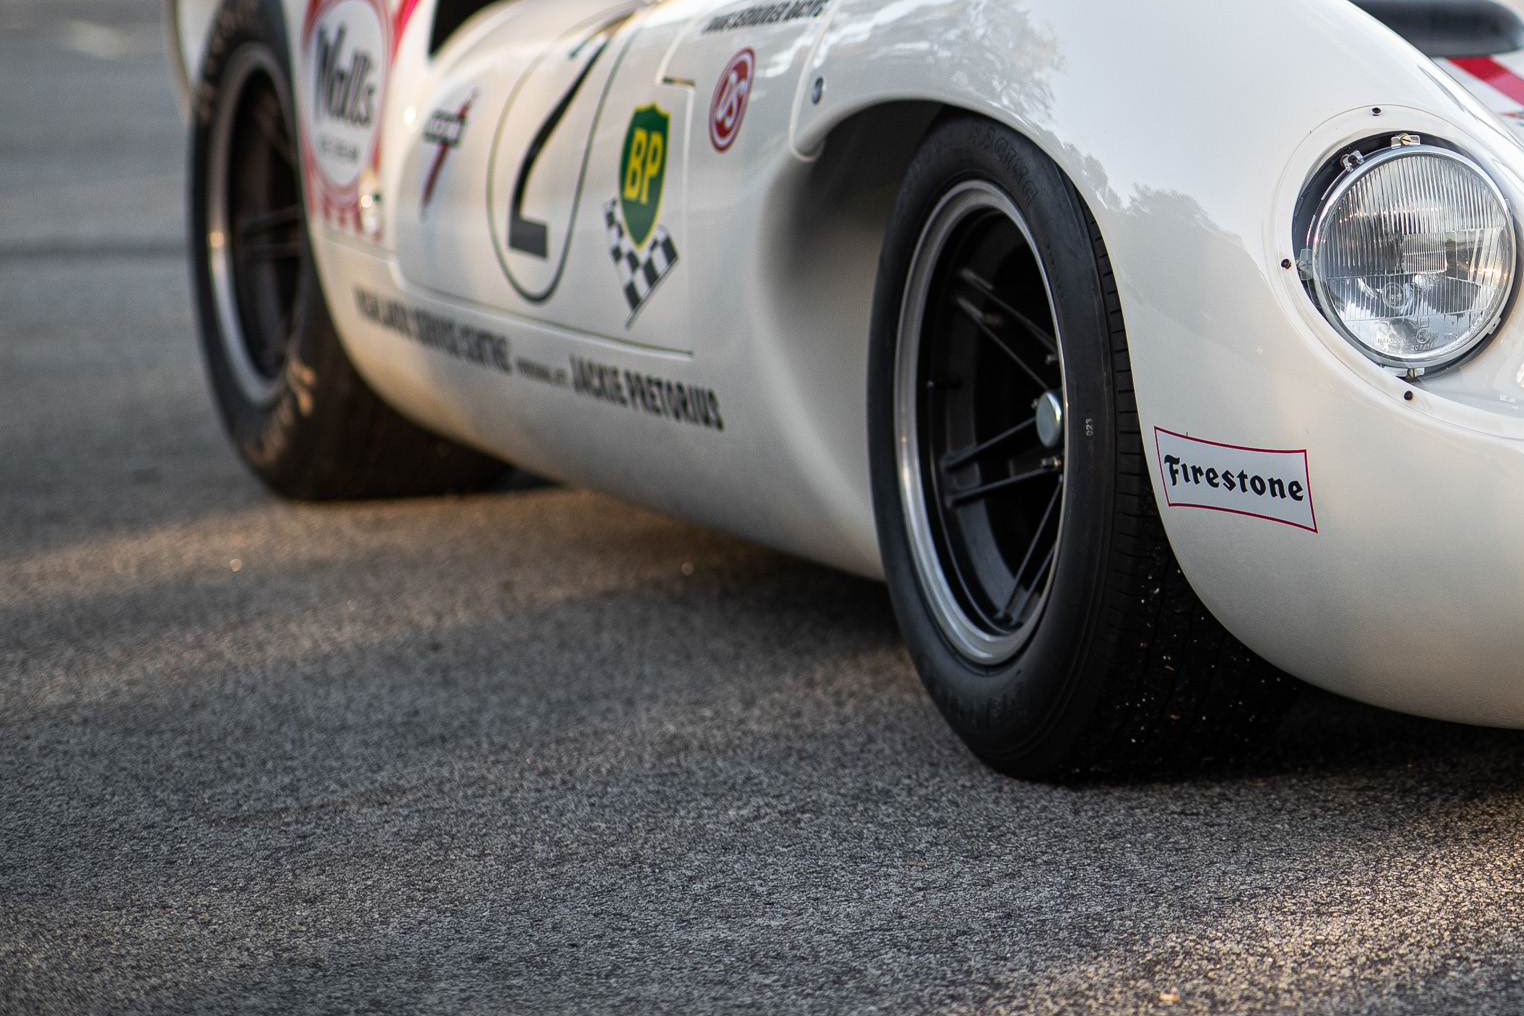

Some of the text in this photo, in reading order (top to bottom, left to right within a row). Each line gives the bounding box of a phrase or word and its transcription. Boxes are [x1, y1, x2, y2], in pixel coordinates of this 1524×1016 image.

[507, 9, 637, 259] 2
[624, 127, 664, 205] BP
[624, 369, 725, 432] PRETORIUS
[1163, 454, 1304, 502] Firestone
